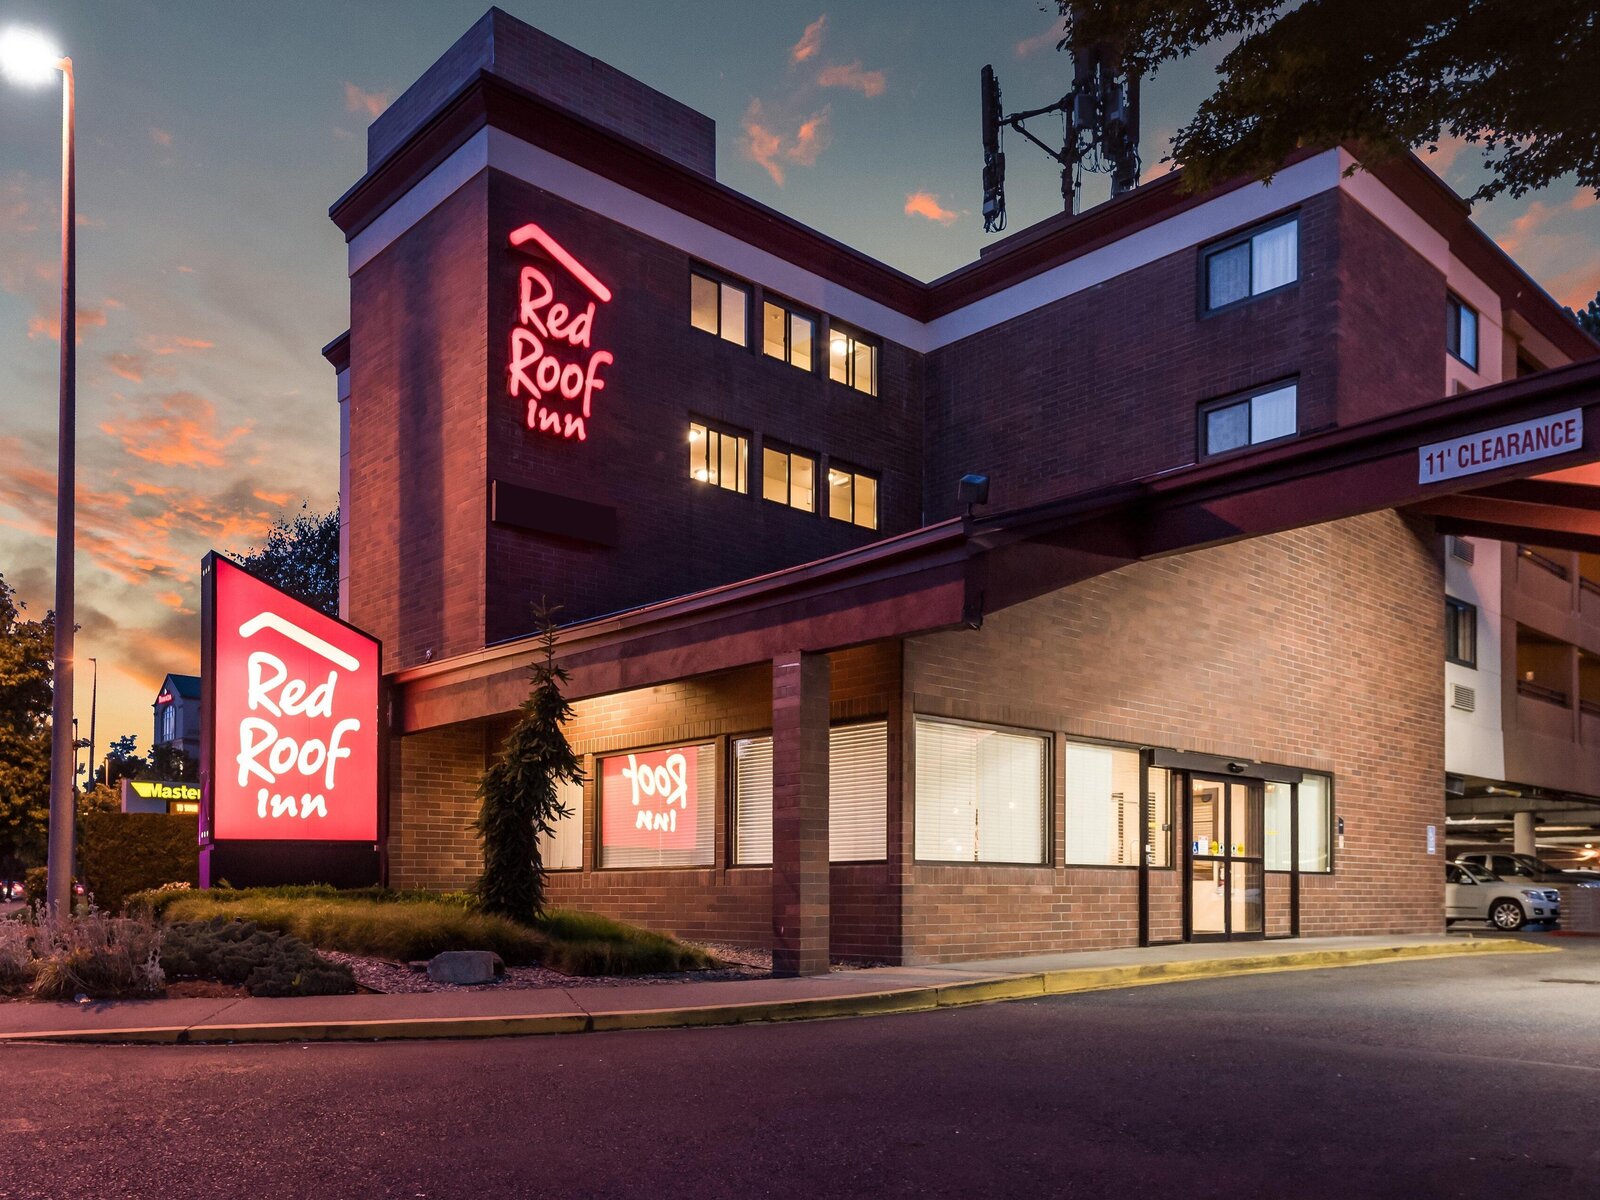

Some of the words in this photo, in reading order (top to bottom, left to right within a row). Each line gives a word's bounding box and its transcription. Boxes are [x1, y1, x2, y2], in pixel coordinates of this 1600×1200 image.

[520, 266, 595, 348] Red
[509, 327, 614, 418] Roof
[527, 399, 586, 441] Inn
[1425, 449, 1451, 475] 11'
[1458, 419, 1576, 468] CLEARANCE
[248, 651, 338, 718] Red
[236, 717, 360, 790] Roof
[257, 788, 327, 819] Inn
